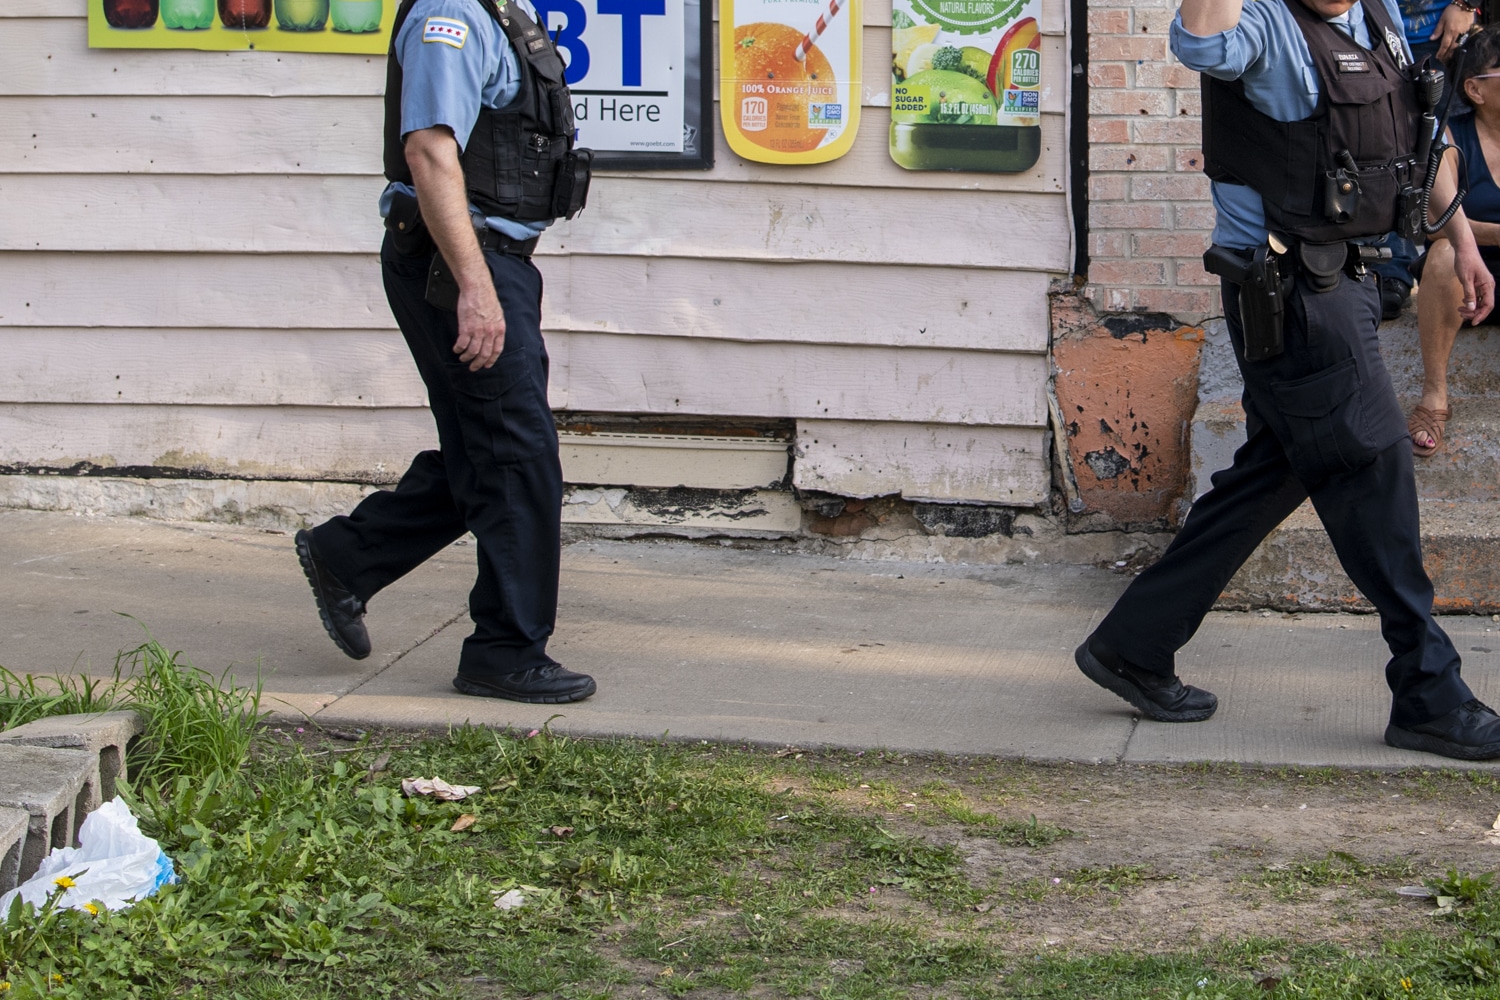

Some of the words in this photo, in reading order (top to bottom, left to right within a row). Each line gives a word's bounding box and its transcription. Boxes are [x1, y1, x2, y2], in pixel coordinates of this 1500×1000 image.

[940, 1, 967, 14] NATURAL
[967, 2, 995, 15] FLAVORS
[1015, 52, 1037, 69] 270
[1013, 68, 1039, 77] CALORIES
[741, 84, 765, 94] 100%
[895, 87, 908, 95] NO
[600, 98, 661, 122] Here
[744, 101, 765, 115] 170
[940, 103, 953, 114] 15.2
[629, 140, 676, 148] www.goebt.com
